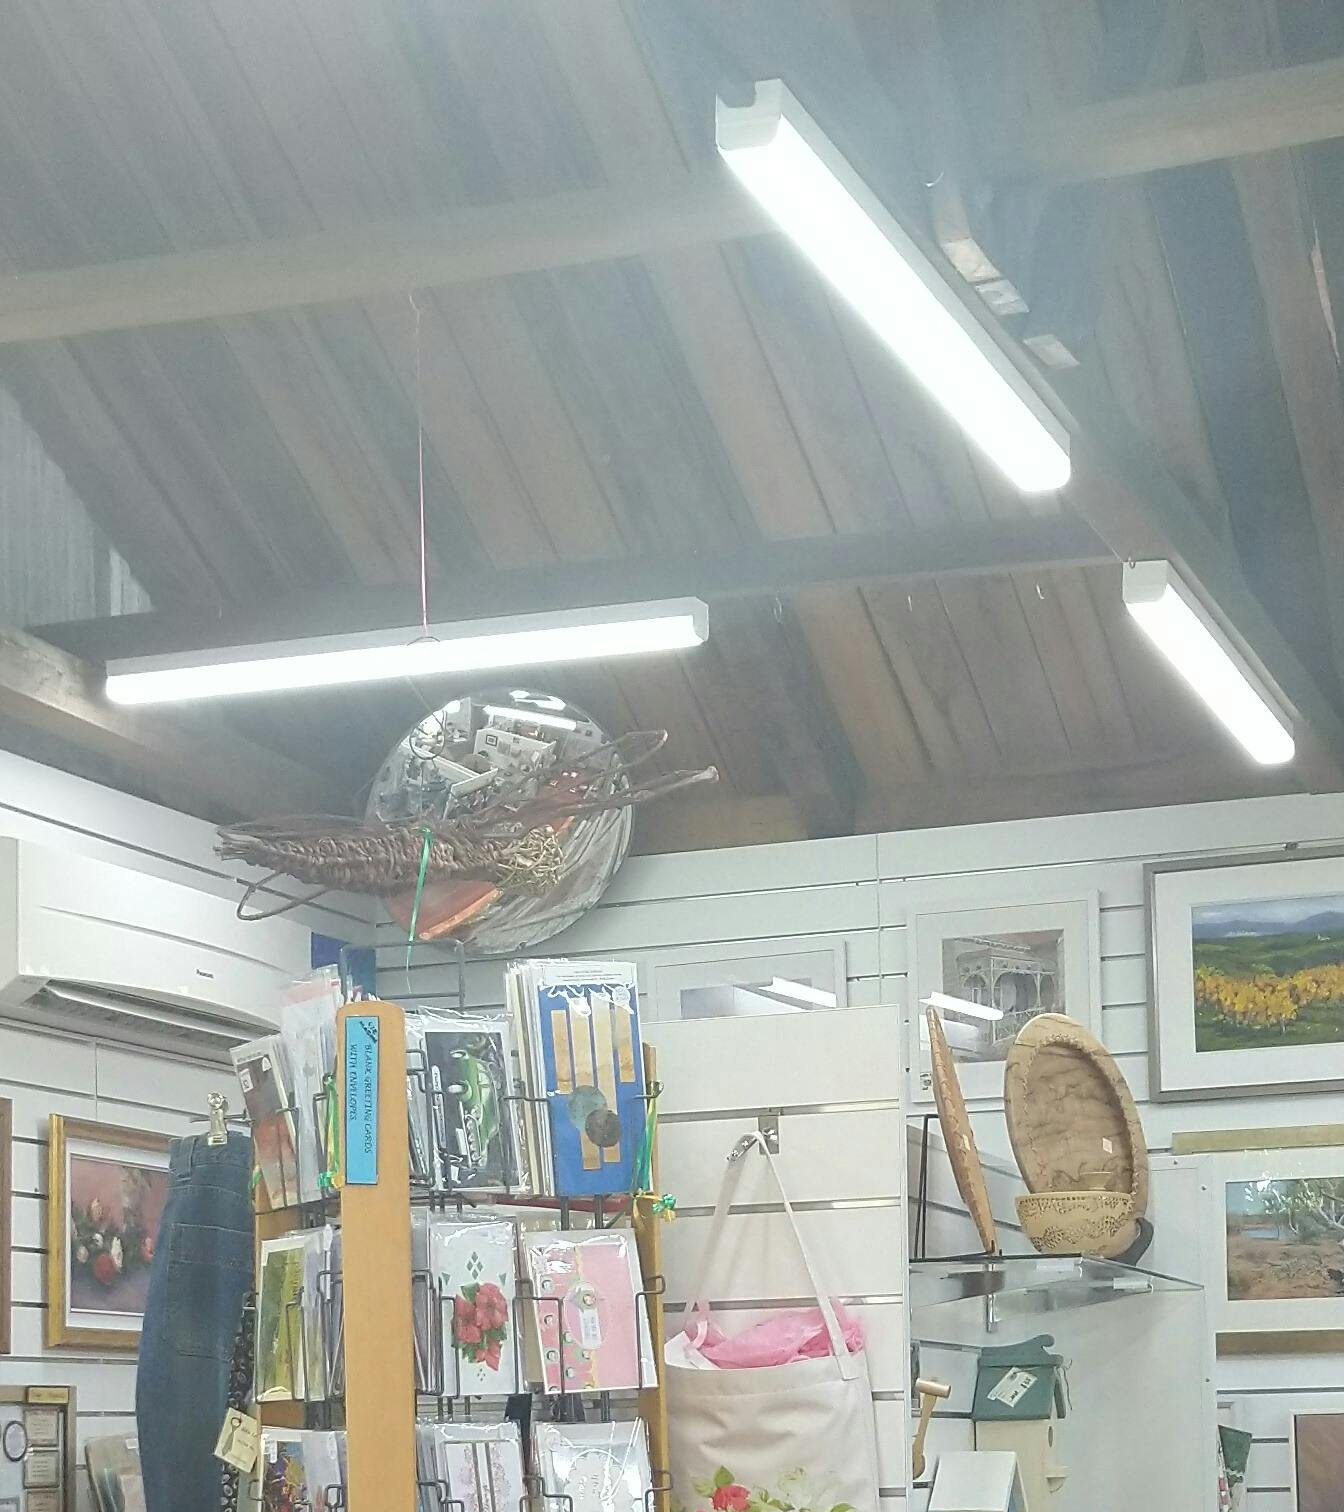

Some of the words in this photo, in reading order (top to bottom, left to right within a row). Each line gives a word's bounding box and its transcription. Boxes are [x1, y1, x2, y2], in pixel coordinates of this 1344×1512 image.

[349, 1043, 358, 1068] WITH
[364, 1043, 373, 1075] BLANK
[349, 1071, 358, 1121] ENVELOPES
[363, 1076, 373, 1122] GREETING
[363, 1124, 374, 1154] CARDS
